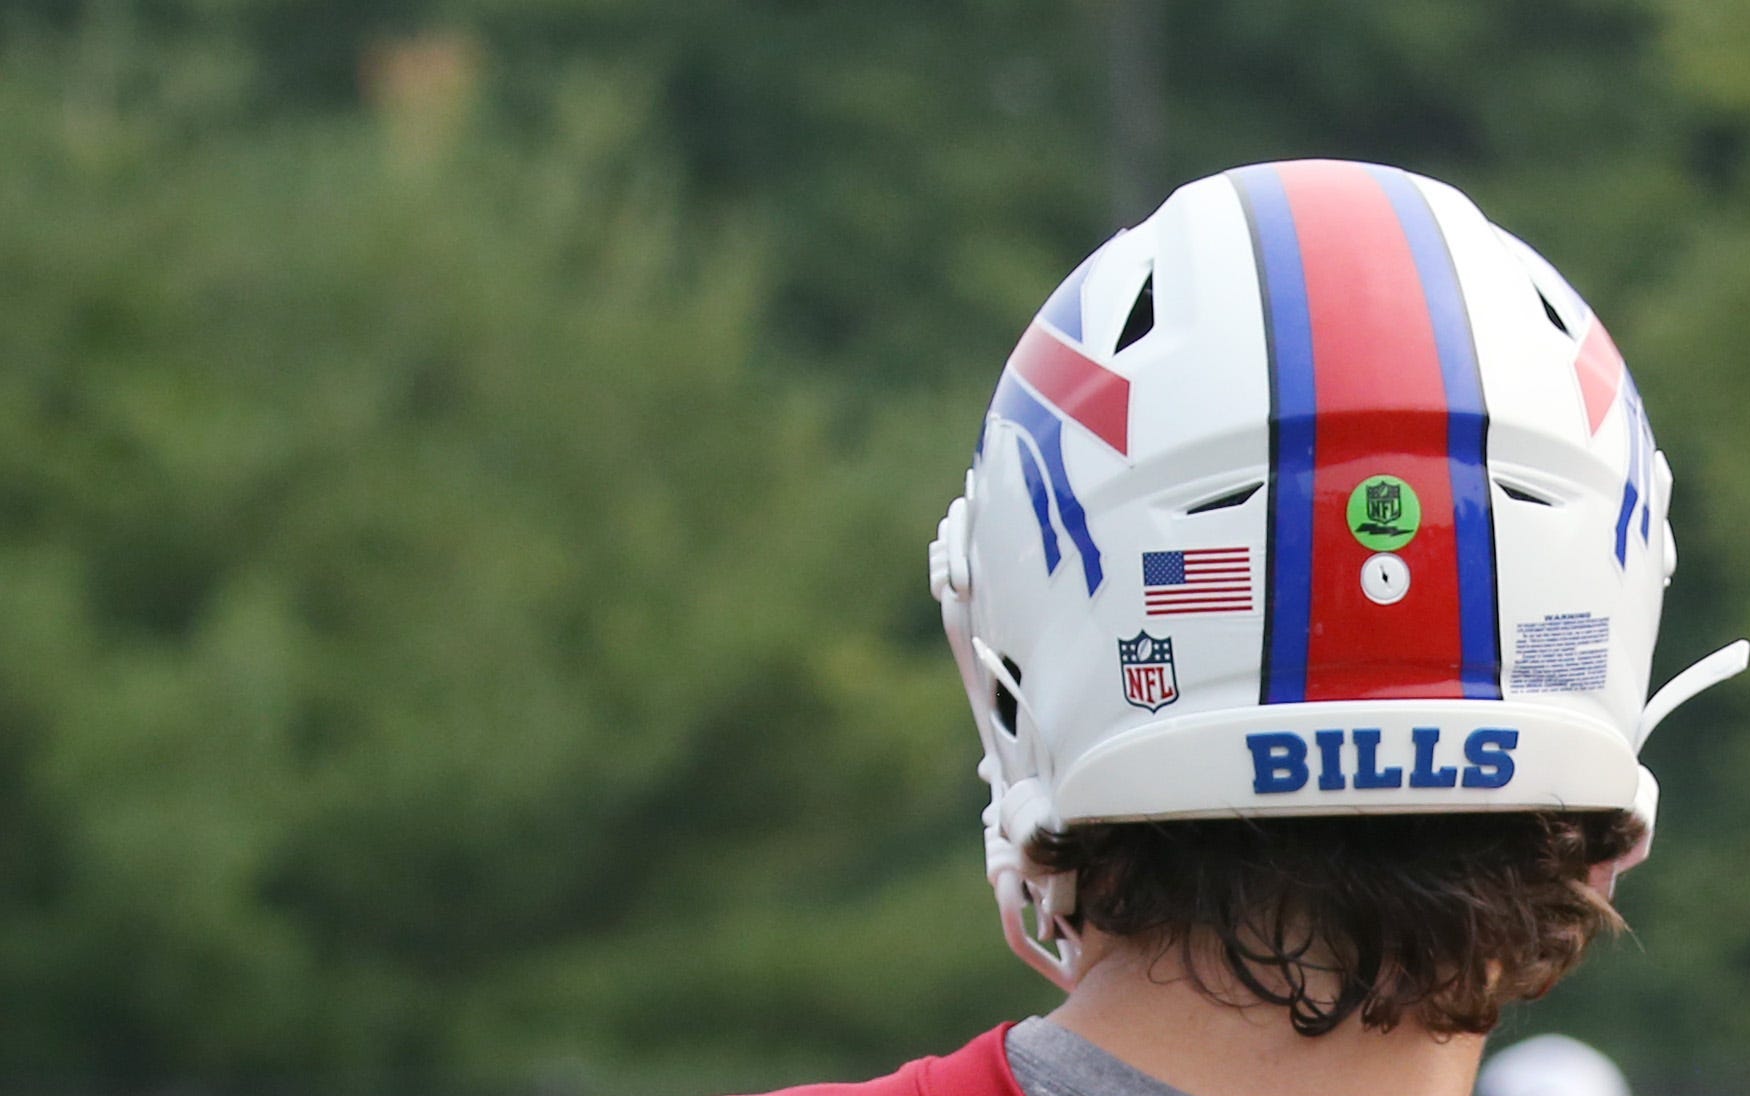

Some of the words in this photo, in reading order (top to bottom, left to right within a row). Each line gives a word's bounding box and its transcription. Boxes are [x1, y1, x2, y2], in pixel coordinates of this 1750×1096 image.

[1369, 500, 1401, 520] NFL
[1126, 667, 1173, 704] NFL
[1246, 728, 1519, 795] BILLS
